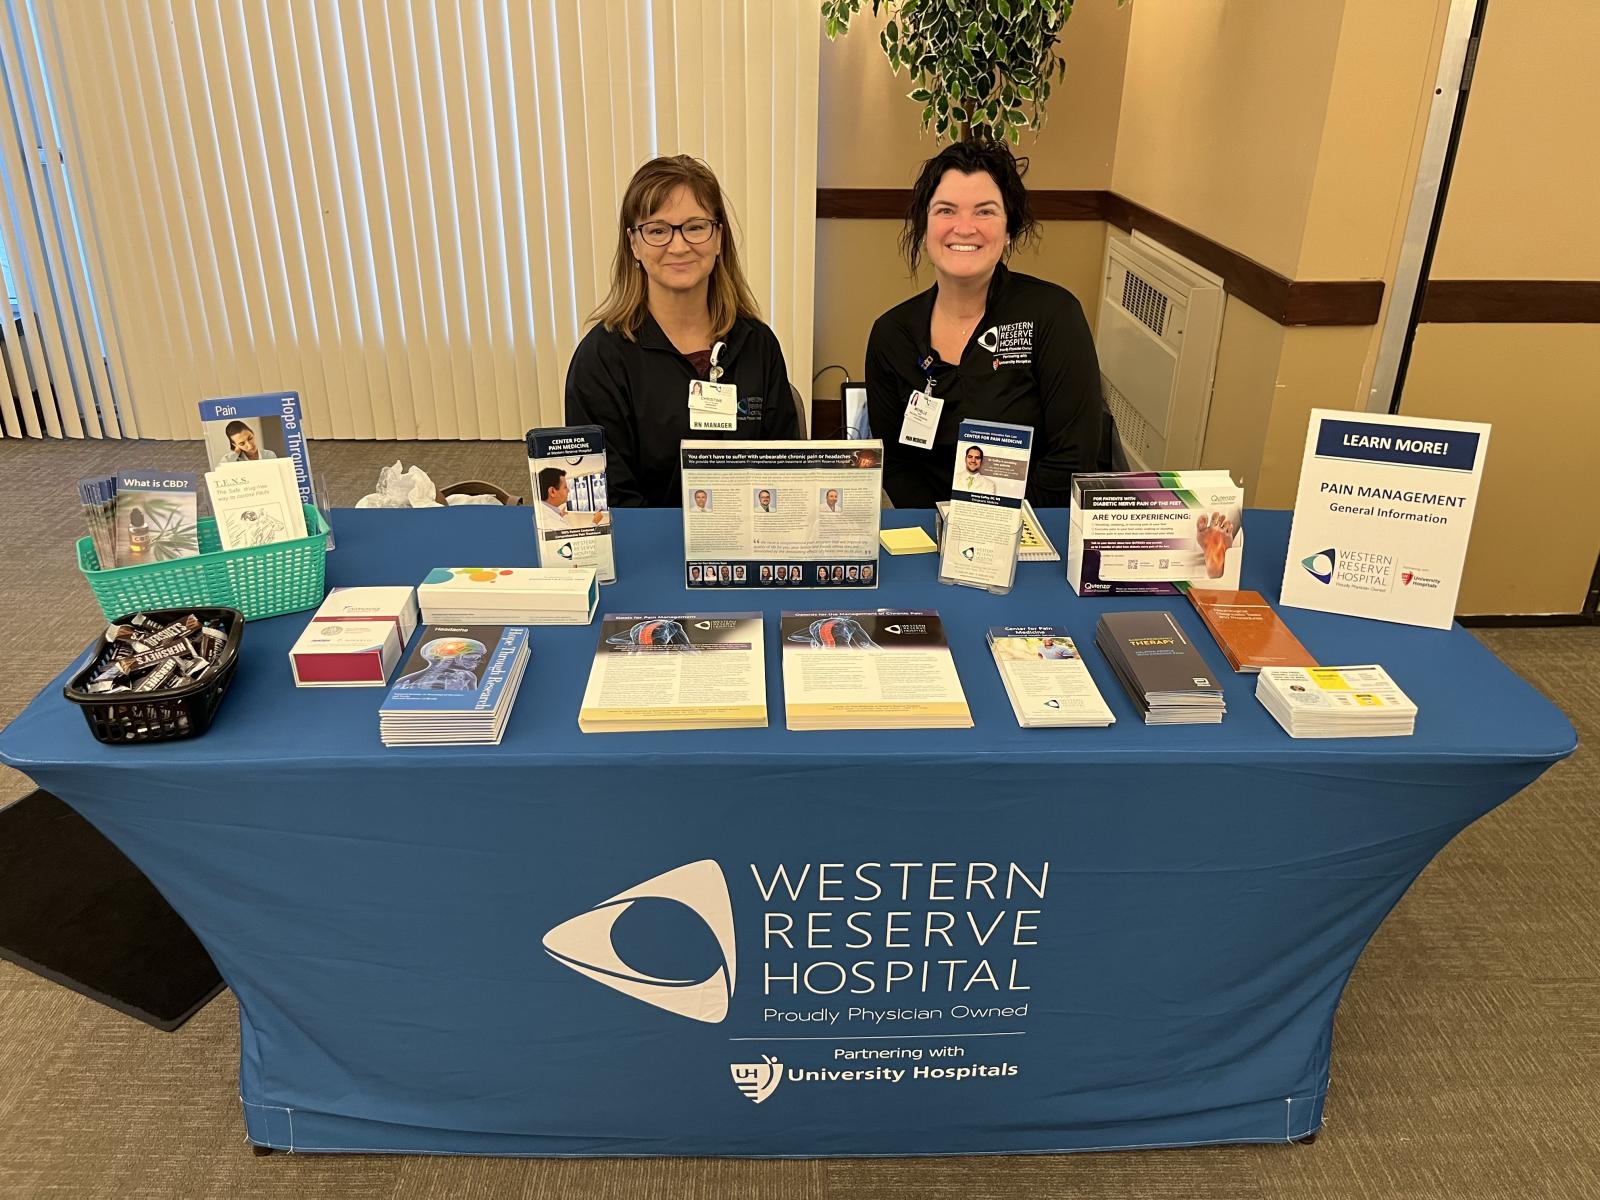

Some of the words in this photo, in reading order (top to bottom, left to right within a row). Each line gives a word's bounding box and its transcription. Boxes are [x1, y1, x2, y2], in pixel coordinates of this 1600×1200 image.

[1000, 321, 1034, 332] WESTERN
[1000, 330, 1033, 340] RESERVE
[1000, 338, 1032, 347] HOSPITAL
[216, 405, 236, 416] Pain
[281, 397, 296, 430] Hope
[1343, 433, 1391, 450] LEARN
[1394, 439, 1448, 455] MORE!
[288, 432, 308, 484] Through
[124, 478, 150, 487] What
[1320, 482, 1354, 496] PAIN
[1358, 486, 1466, 508] MANAGEMENT
[1329, 502, 1374, 516] General
[1377, 508, 1447, 525] Information
[1338, 561, 1390, 575] RESERVE
[1339, 550, 1393, 565] WESTERN
[1337, 572, 1387, 586] HOSPITAL
[1413, 576, 1440, 584] University
[502, 628, 524, 646] Hope
[137, 642, 186, 665] HERSHEY'S
[490, 647, 514, 675] Through
[475, 676, 503, 710] Research
[750, 862, 1049, 902] WESTERN
[764, 910, 1041, 949] RESERVE
[764, 959, 1031, 995] HOSPITAL
[764, 1008, 840, 1025] Proudly
[848, 1007, 942, 1024] Physician
[951, 1004, 1028, 1020] Owned
[834, 1047, 923, 1061] Partnering
[929, 1046, 965, 1058] with
[735, 1068, 758, 1079] UH
[788, 1067, 906, 1083] University
[913, 1062, 1018, 1081] Hospitals
